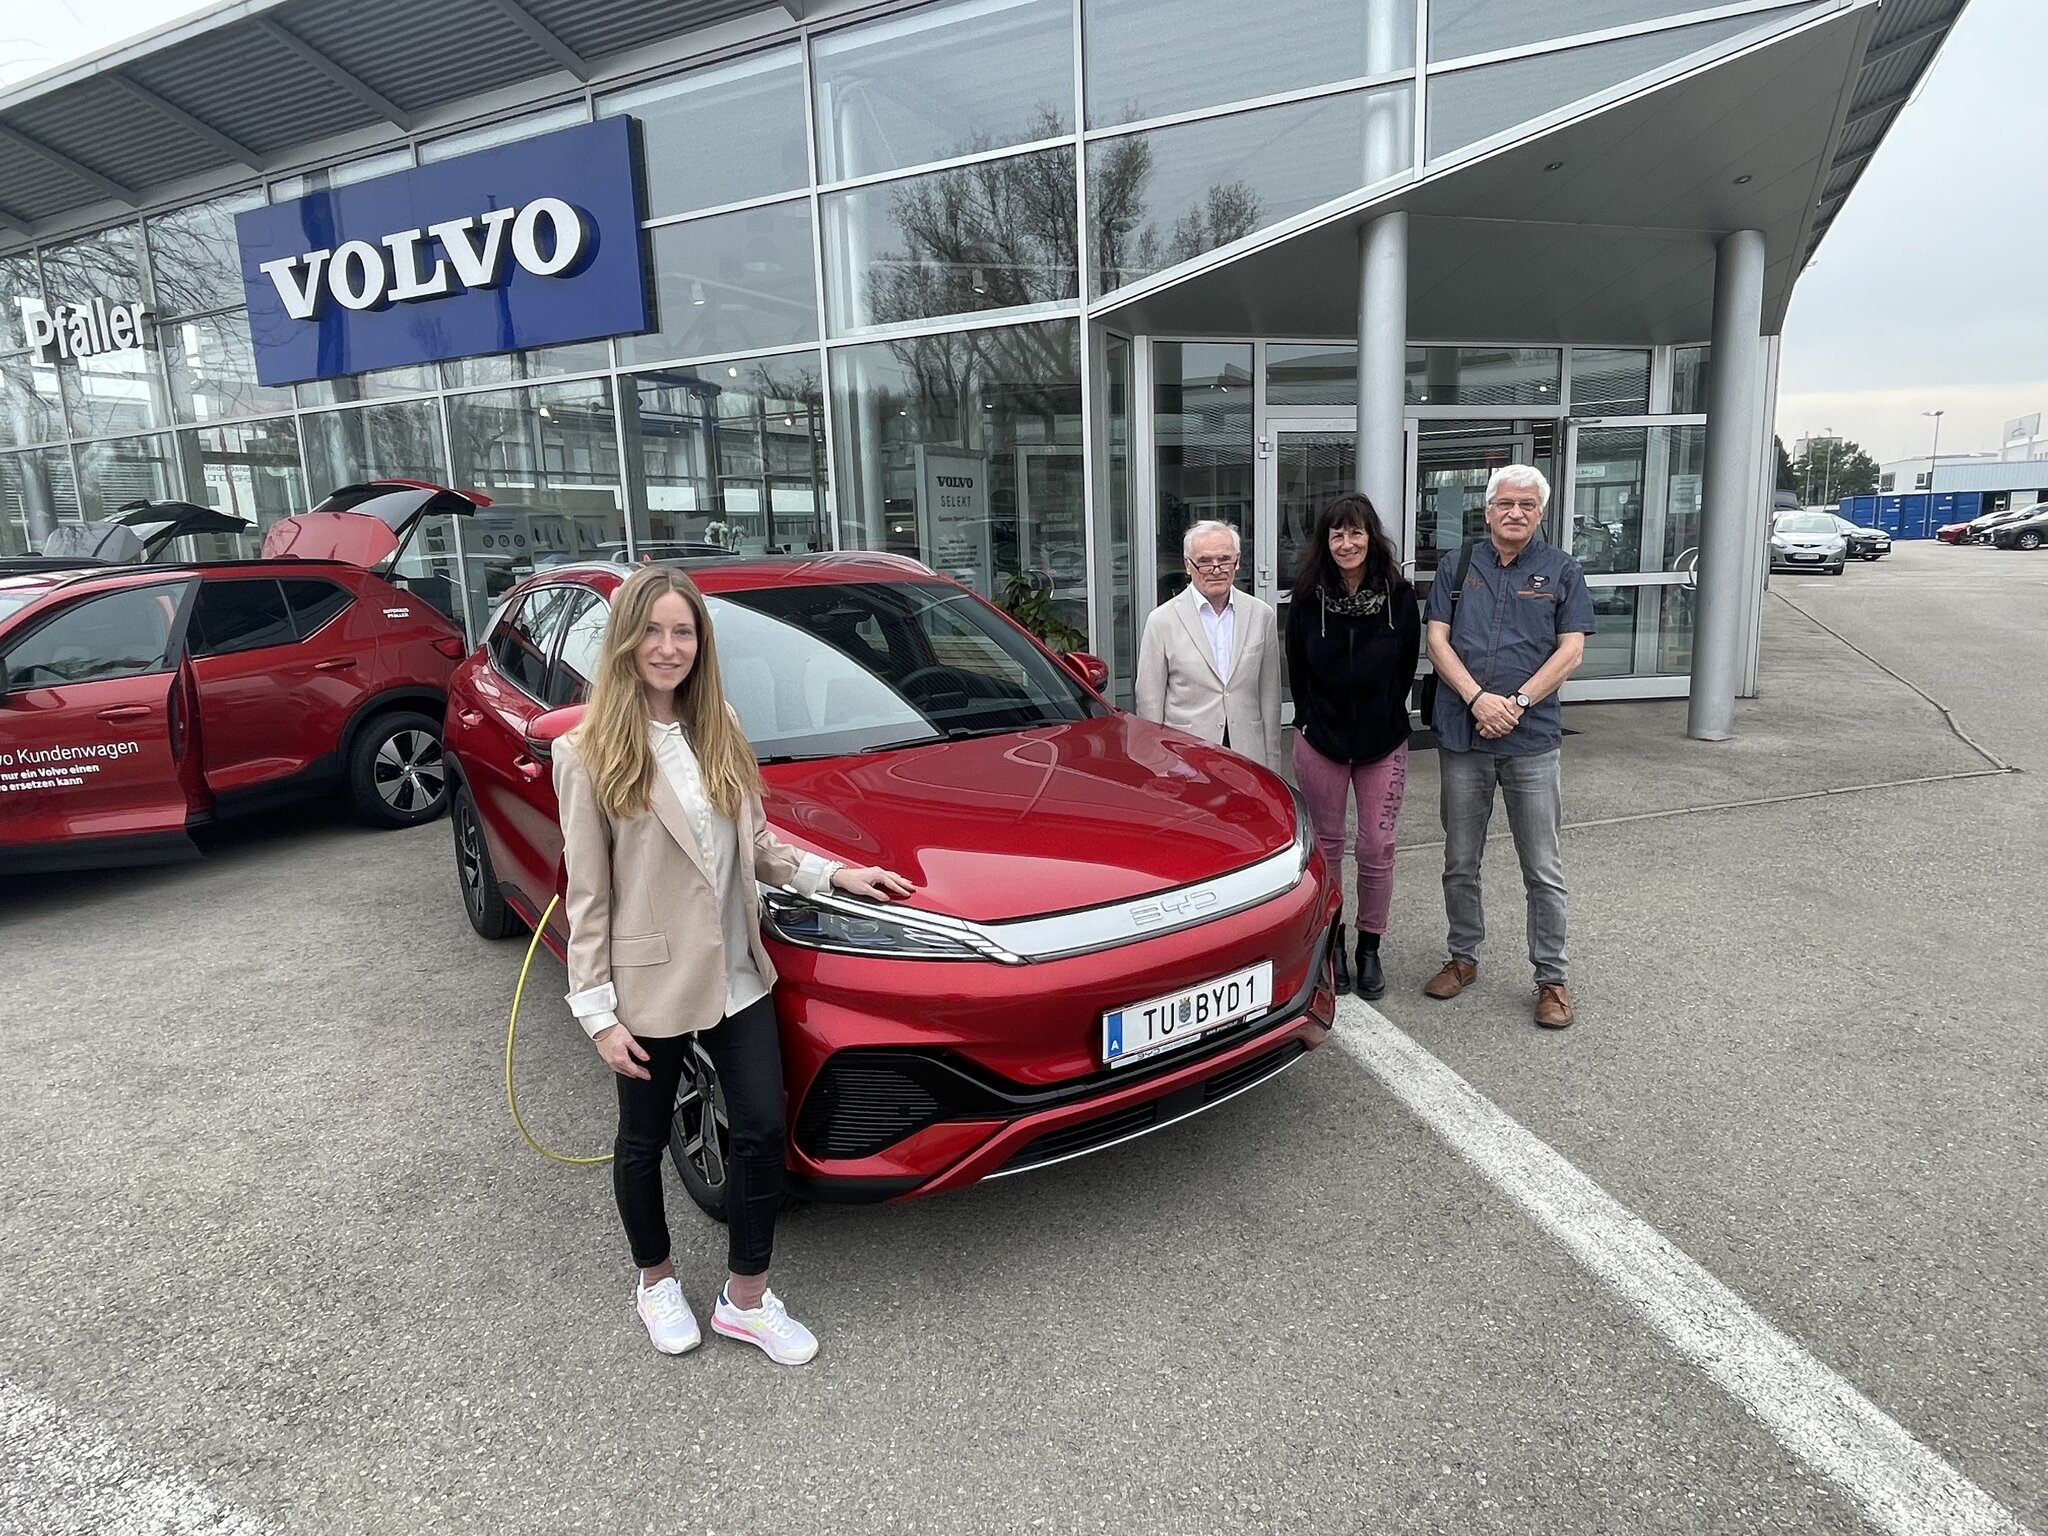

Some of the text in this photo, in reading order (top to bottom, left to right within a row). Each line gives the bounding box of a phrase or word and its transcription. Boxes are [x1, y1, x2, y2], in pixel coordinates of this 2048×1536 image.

[259, 196, 582, 320] VOLVO
[28, 297, 145, 363] Pfaller
[936, 475, 974, 489] VOLVO
[940, 495, 971, 508] SELEKT
[17, 741, 139, 764] Kundenwagen
[1, 764, 100, 781] nur ein Volvo einen
[9, 780, 55, 791] ersetzen
[56, 777, 83, 787] kann
[1379, 754, 1405, 832] DREAMS
[1129, 889, 1217, 926] BYD
[1110, 1040, 1119, 1050] A
[1143, 1003, 1175, 1040] TU
[1196, 981, 1240, 1024] BYD
[1246, 975, 1254, 1004] 1
